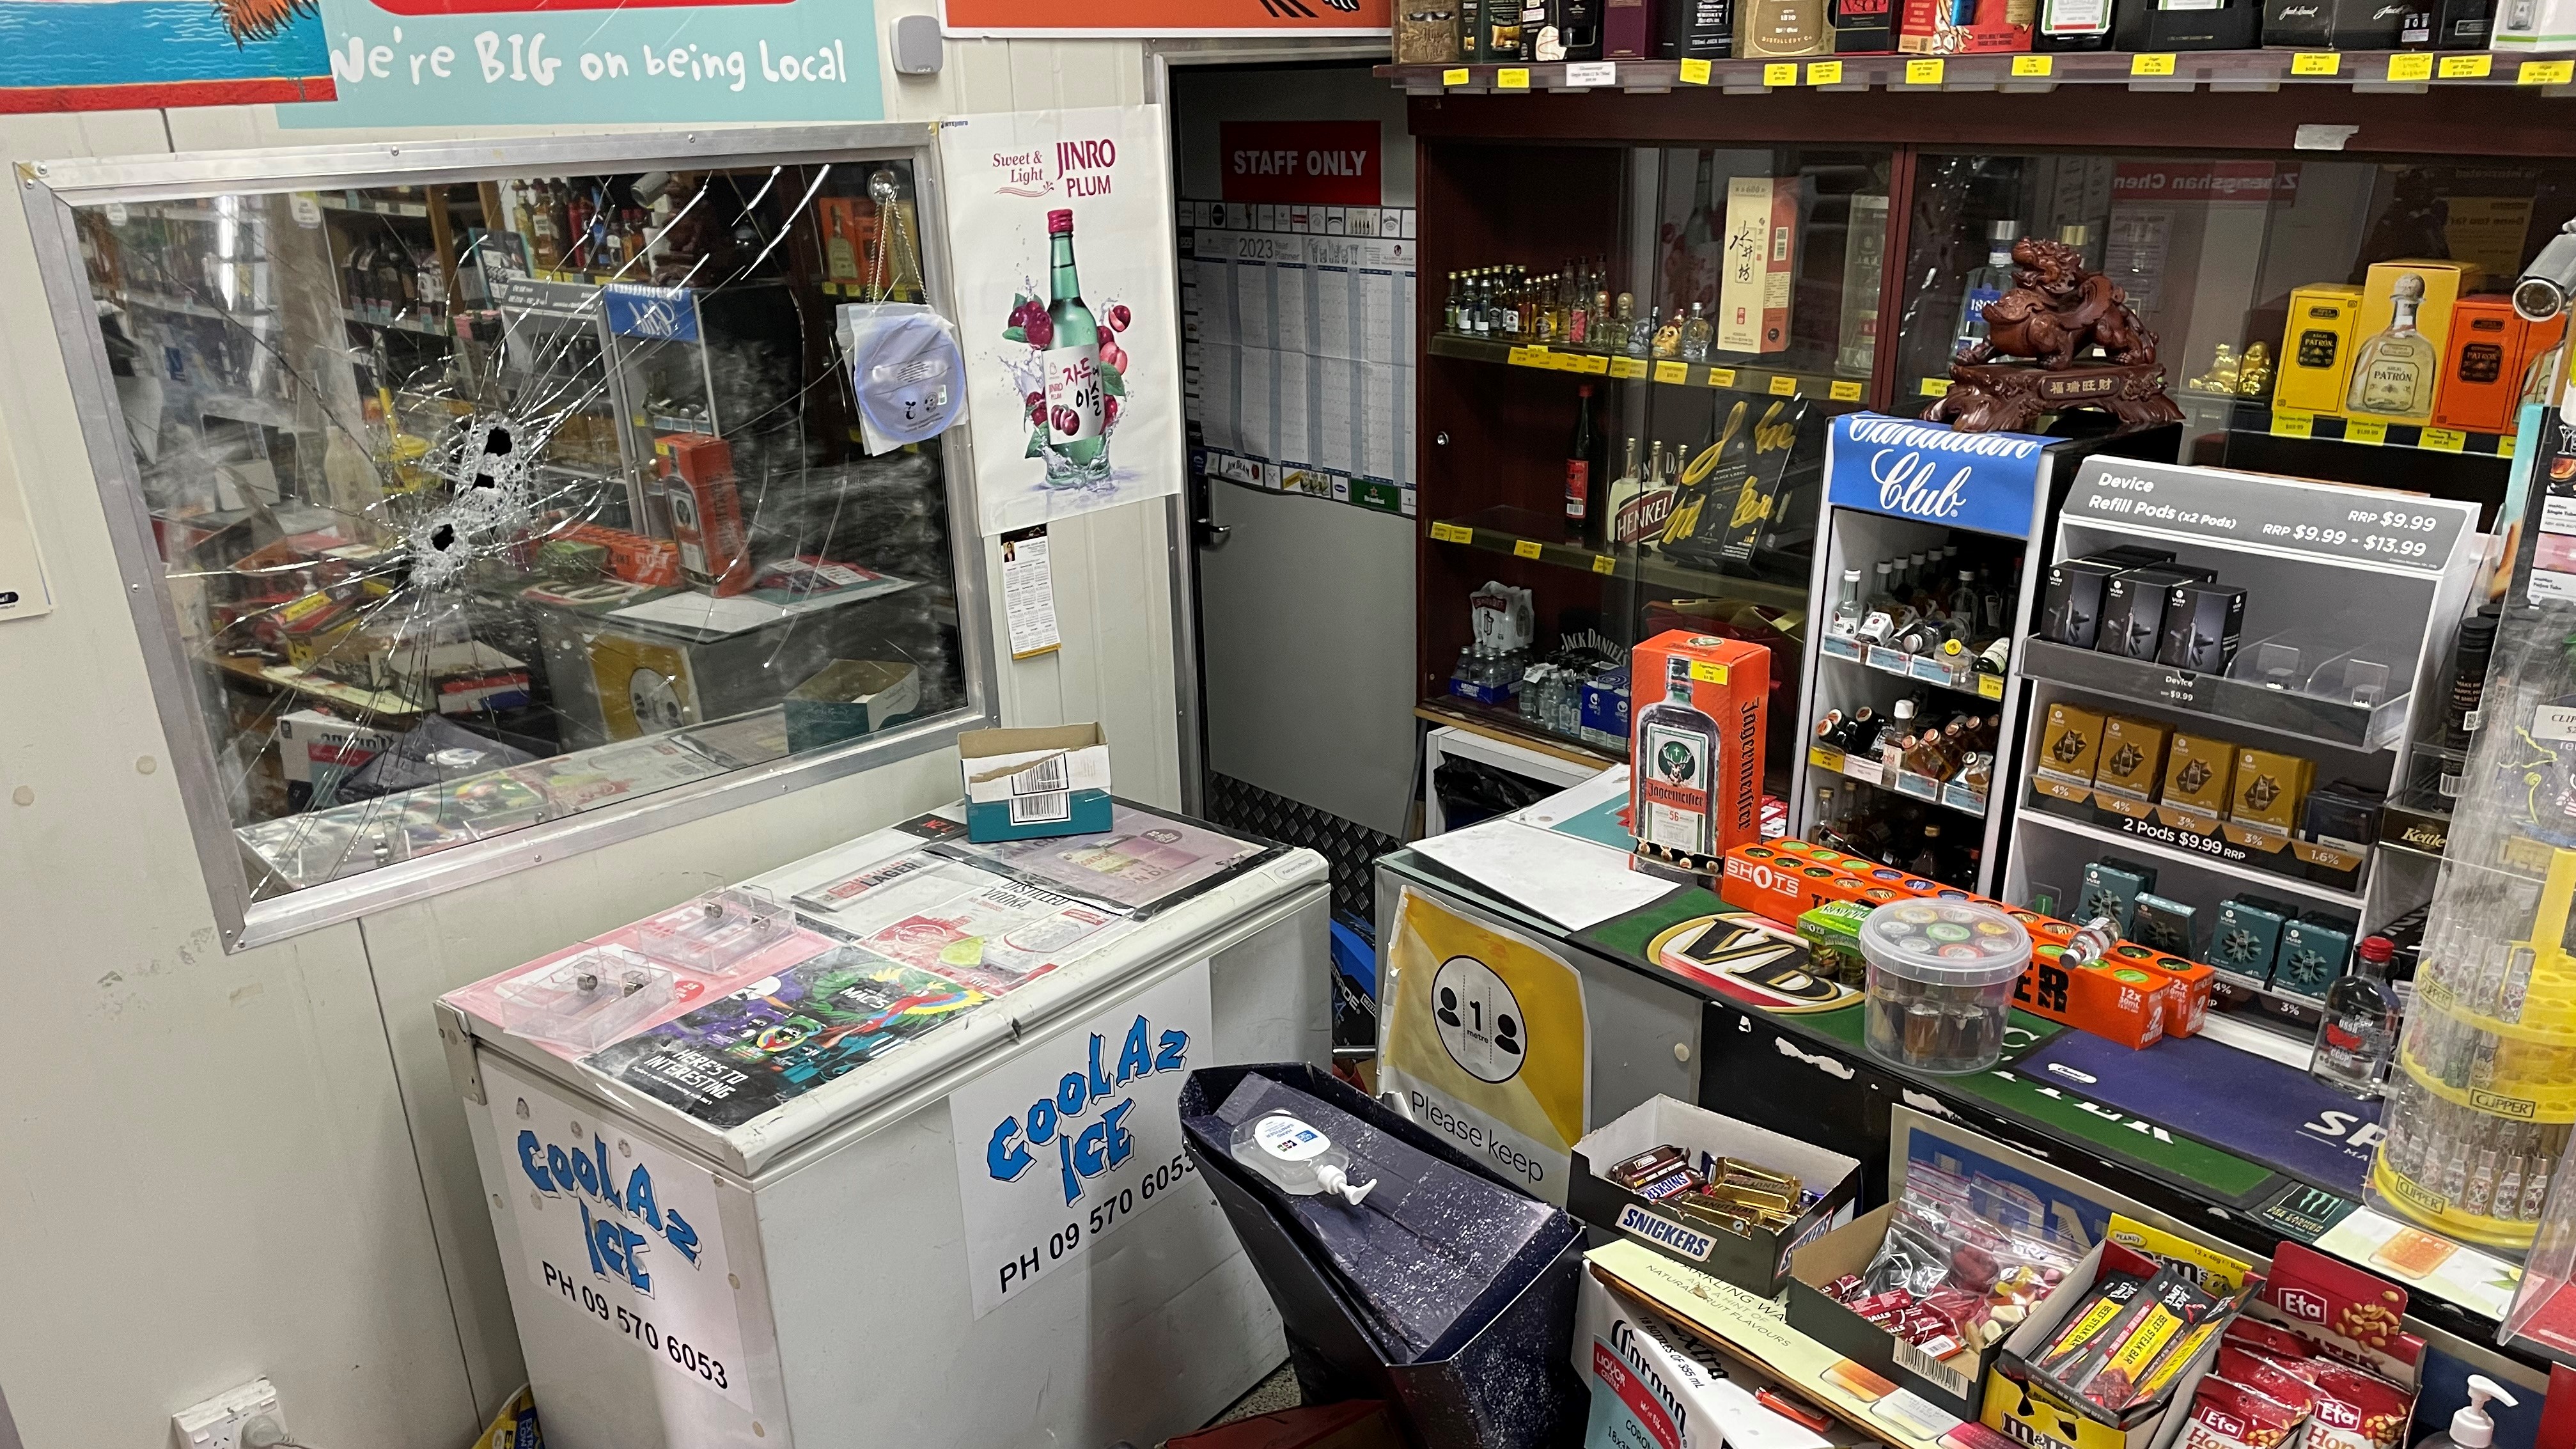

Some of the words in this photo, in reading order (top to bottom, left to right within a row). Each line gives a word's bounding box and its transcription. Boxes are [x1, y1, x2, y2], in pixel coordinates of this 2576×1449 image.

[474, 31, 562, 86] BIG
[581, 51, 628, 81] on
[644, 43, 745, 91] being
[993, 153, 1030, 168] Sweet
[1034, 150, 1043, 164] &
[1056, 139, 1116, 180] JINRO
[1234, 150, 1298, 176] STAFF
[1306, 149, 1367, 176] ONLY
[1010, 167, 1043, 185] Light
[1066, 175, 1111, 198] PLUM
[1239, 238, 1274, 258] 2023
[2374, 370, 2412, 382] PATRÓN
[1871, 449, 1967, 517] Club
[2098, 473, 2154, 494] Device
[2089, 494, 2132, 514] Refill
[2134, 501, 2176, 521] Pods
[2178, 510, 2199, 524] (x2
[2201, 513, 2236, 530] Pods)
[2263, 523, 2291, 538] RRP
[2293, 524, 2347, 546] $9.99
[2363, 533, 2426, 558] $13.99
[2348, 510, 2378, 524] RRP
[2380, 510, 2437, 533] $9.99
[1561, 632, 1585, 654] JACK
[1588, 628, 1629, 666] DANIEL'S
[2166, 676, 2194, 688] Device
[2171, 691, 2194, 701] $9.99
[2052, 785, 2069, 797] 4%
[1669, 810, 1680, 822] 56
[2112, 801, 2130, 813] 4%
[2178, 816, 2195, 829] 3%
[2123, 818, 2134, 832] 2
[2137, 821, 2176, 843] Pods
[2178, 831, 2222, 854] $9.99
[2224, 848, 2245, 861] RRP
[2244, 833, 2263, 847] 3%
[2401, 828, 2447, 848] Kettle
[2311, 850, 2339, 866] 1.6%
[861, 861, 923, 888] LAGER
[1727, 857, 1799, 898] SHOTS
[1001, 880, 1071, 906] DISTILLED
[2121, 987, 2142, 1002] 12x
[2213, 982, 2231, 995] 4%
[1470, 1000, 1482, 1031] 1
[2281, 1001, 2300, 1015] 3%
[1467, 1029, 1488, 1044] metre
[643, 1055, 736, 1099] INTERESTING
[672, 1049, 724, 1076] HERE'S
[722, 1069, 749, 1085] TO
[2474, 1093, 2533, 1115] CLIPPER
[1411, 1090, 1483, 1148] Please
[1488, 1129, 1545, 1185] keep
[2400, 1180, 2442, 1209] CLIPPER
[999, 1247, 1040, 1294] PH
[1049, 1223, 1080, 1260] 09
[1089, 1188, 1134, 1235] 570
[1623, 1209, 1710, 1257] SNICKERS
[2116, 1234, 2141, 1244] PEANUT
[1646, 1264, 1694, 1294] NATURAL
[1703, 1296, 1731, 1312] RUIT
[1730, 1312, 1791, 1347] FLAVOURS
[1686, 1278, 1712, 1292] AND
[1722, 1297, 1751, 1313] HINT
[1752, 1312, 1770, 1322] OF
[2286, 1294, 2321, 1319] Eta
[542, 1260, 576, 1303] PH
[582, 1285, 609, 1320] 09
[616, 1305, 659, 1351] 570
[667, 1335, 728, 1390] 6053
[2097, 1305, 2112, 1326] BEEF
[2154, 1314, 2168, 1334] BEEF
[1646, 1322, 1676, 1355] BOTTLES
[1670, 1351, 1683, 1365] OF
[2138, 1330, 2159, 1358] STEAK
[2123, 1350, 2140, 1365] BAR
[1596, 1352, 1626, 1387] LIQUOR
[2205, 1411, 2238, 1434] Eta
[2322, 1402, 2357, 1426] Eta
